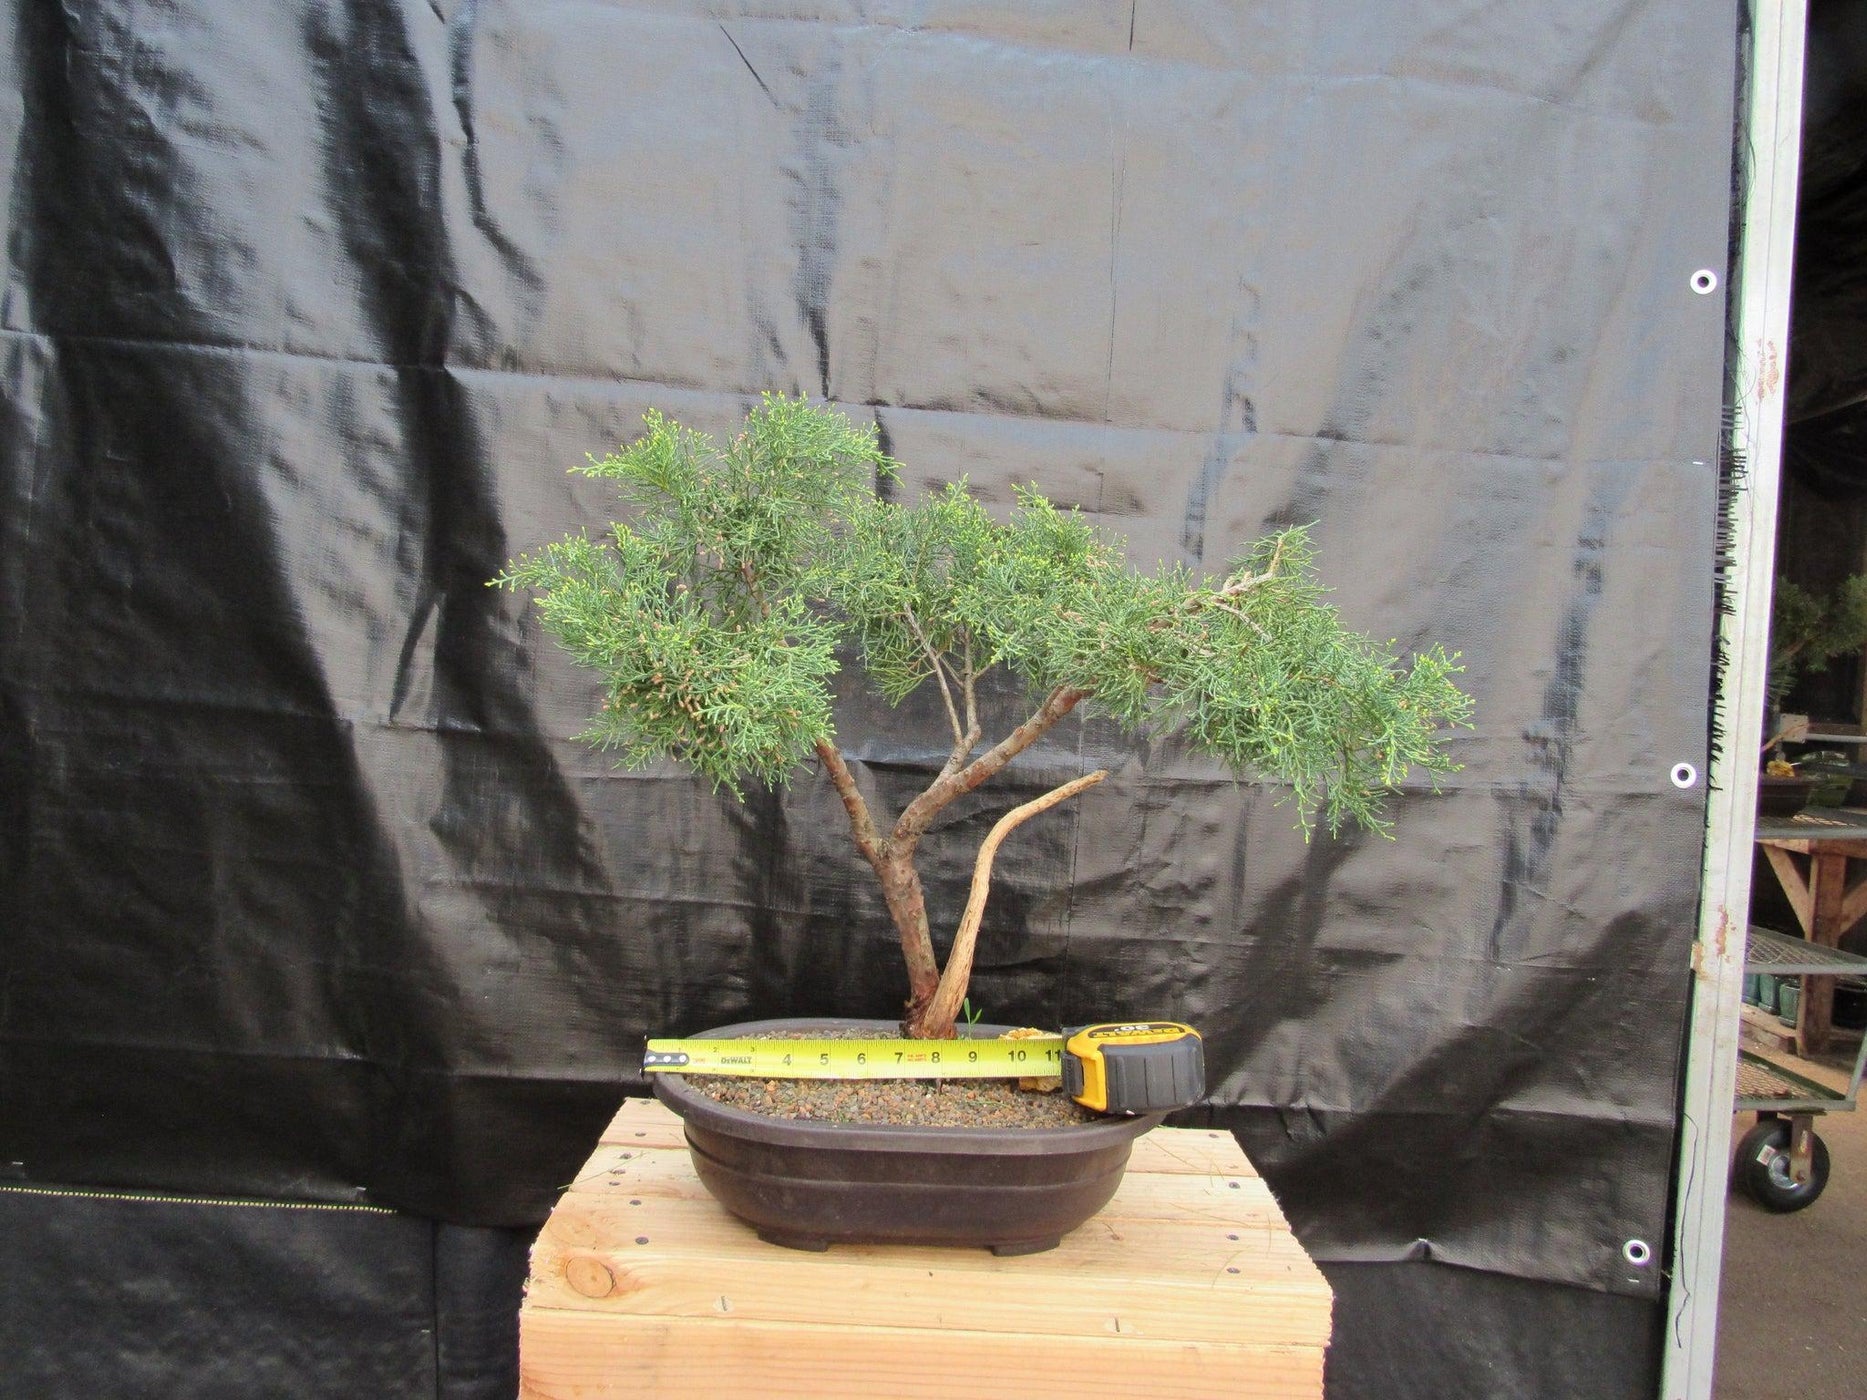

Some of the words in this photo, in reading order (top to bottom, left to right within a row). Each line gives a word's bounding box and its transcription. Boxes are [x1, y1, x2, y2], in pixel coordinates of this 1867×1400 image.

[783, 1053, 792, 1066] 4
[820, 1053, 829, 1066] 5
[857, 1052, 866, 1065] 6
[894, 1051, 903, 1064] 7
[931, 1051, 940, 1064] 8
[968, 1051, 978, 1063] 9
[1007, 1049, 1027, 1061] 10
[1045, 1048, 1061, 1061] 11
